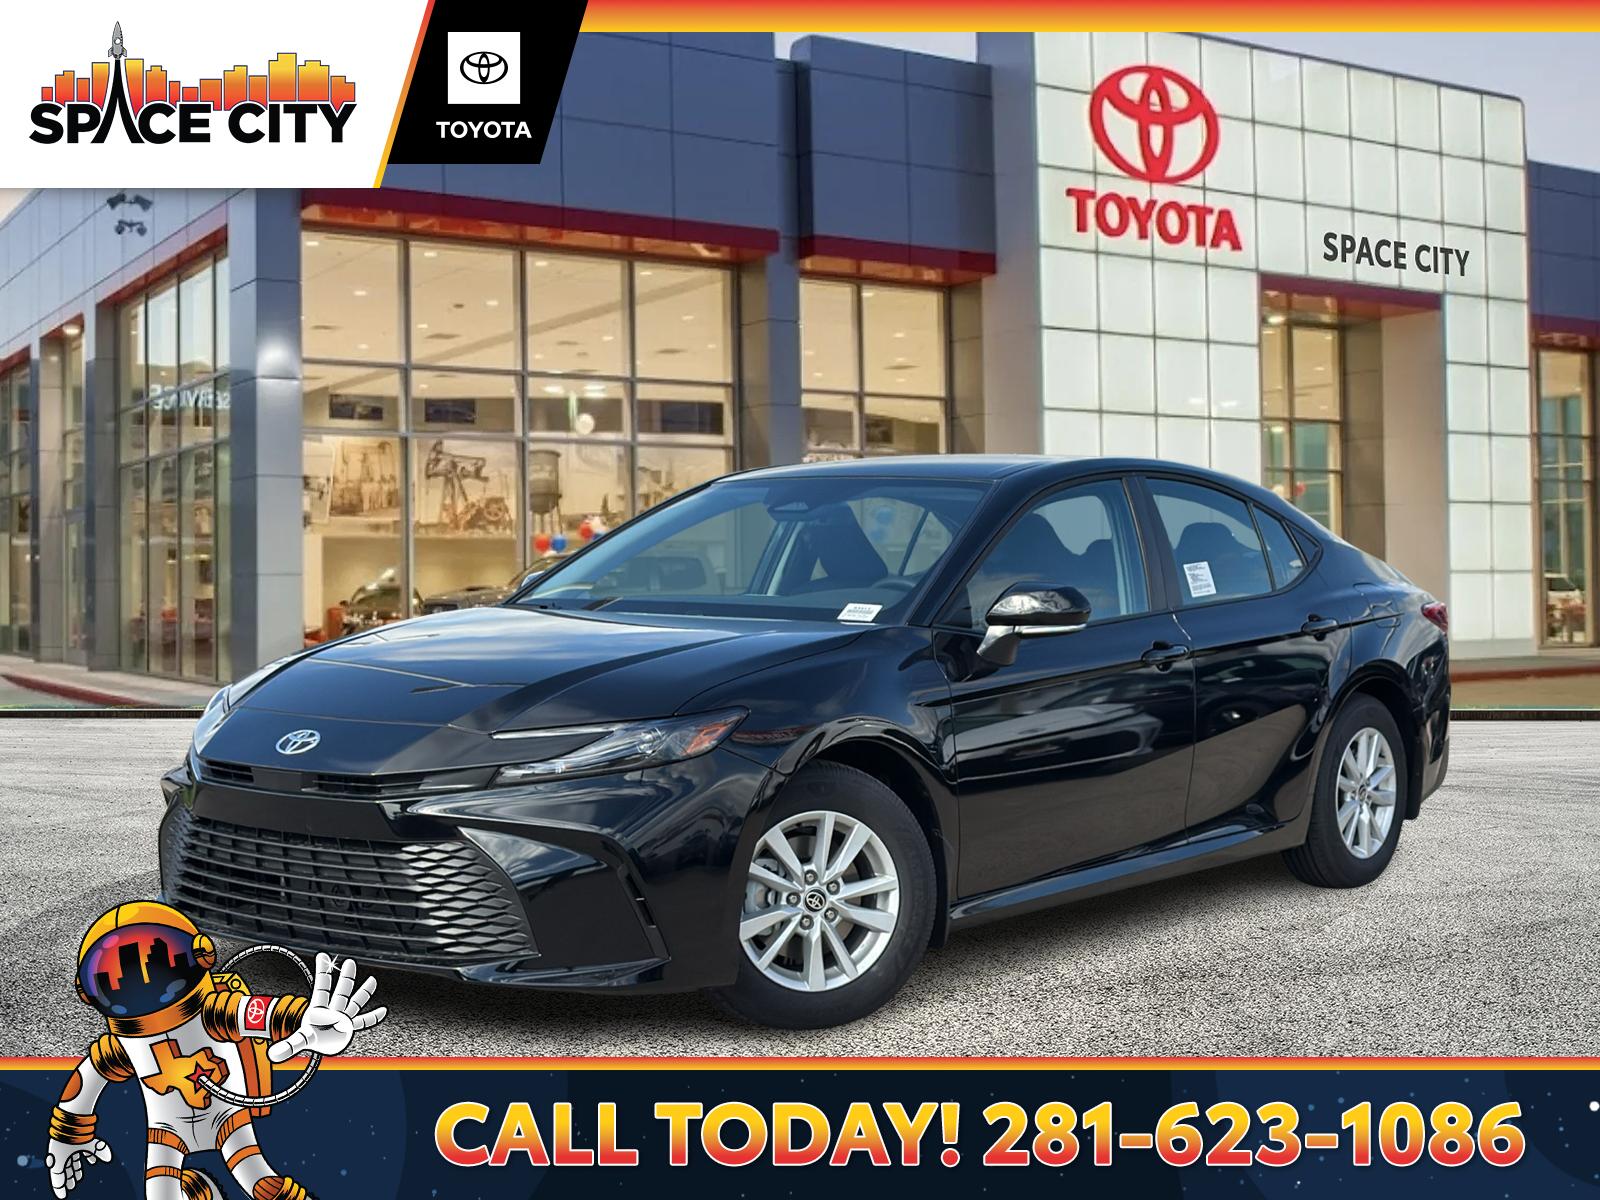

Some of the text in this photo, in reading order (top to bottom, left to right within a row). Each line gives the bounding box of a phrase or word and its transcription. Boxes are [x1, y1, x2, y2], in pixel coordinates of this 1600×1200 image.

[1066, 187, 1242, 251] TOYOTA
[1323, 232, 1470, 277] SPACE CITY
